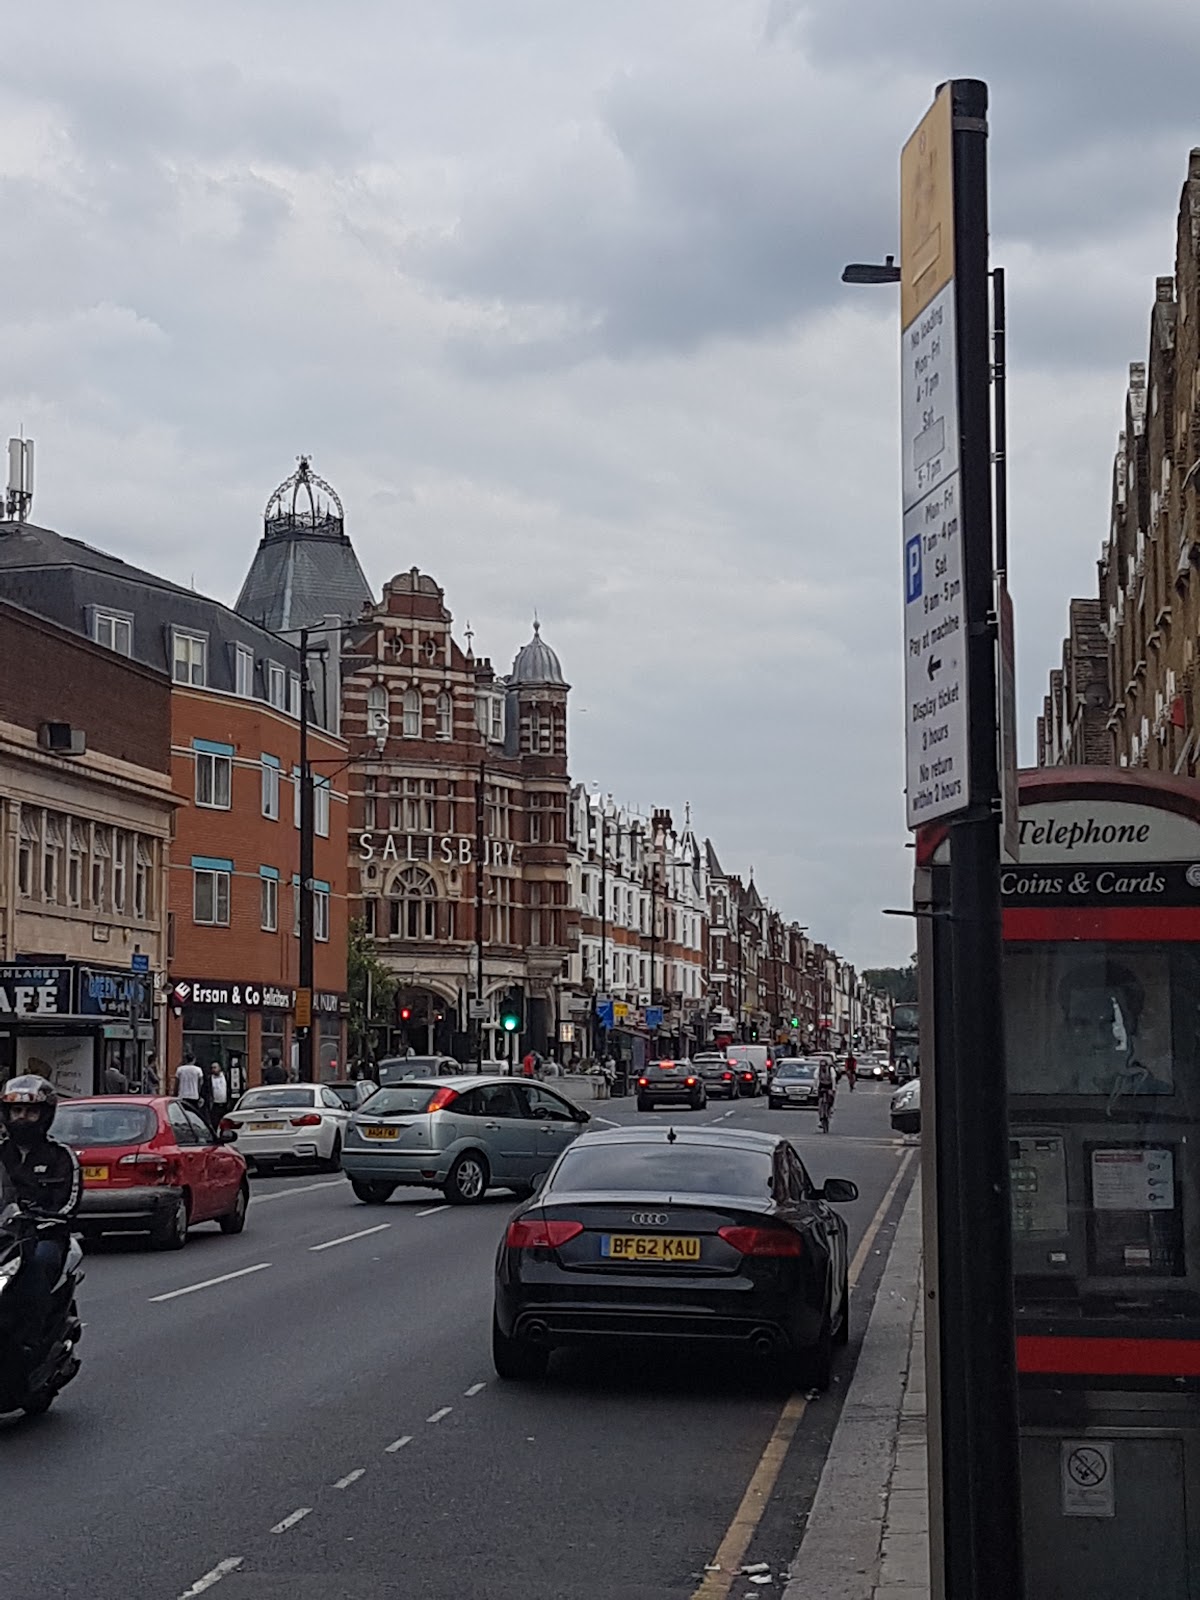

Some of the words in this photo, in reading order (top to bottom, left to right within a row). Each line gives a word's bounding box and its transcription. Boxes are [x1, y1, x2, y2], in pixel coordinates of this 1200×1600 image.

[921, 304, 943, 340] loading
[908, 543, 920, 597] P
[934, 553, 947, 578] Sat
[910, 638, 921, 657] Pay
[923, 629, 930, 649] at
[931, 614, 959, 645] machine
[913, 696, 936, 722] Display
[938, 682, 959, 710] ticket
[929, 723, 949, 746] hours
[919, 764, 929, 783] No
[931, 757, 953, 779] return
[912, 787, 933, 811] within
[934, 783, 940, 802] 2
[941, 779, 961, 801] hours
[1018, 819, 1150, 850] Telephone
[1000, 873, 1063, 894] Coins
[1067, 872, 1090, 893] &
[1096, 871, 1166, 893] Cards
[192, 983, 228, 1004] Ersan
[231, 986, 241, 1004] &
[245, 986, 260, 1005] Co
[262, 987, 289, 1008] Solicitors
[613, 1238, 658, 1255] BF62
[663, 1239, 697, 1257] KAU
